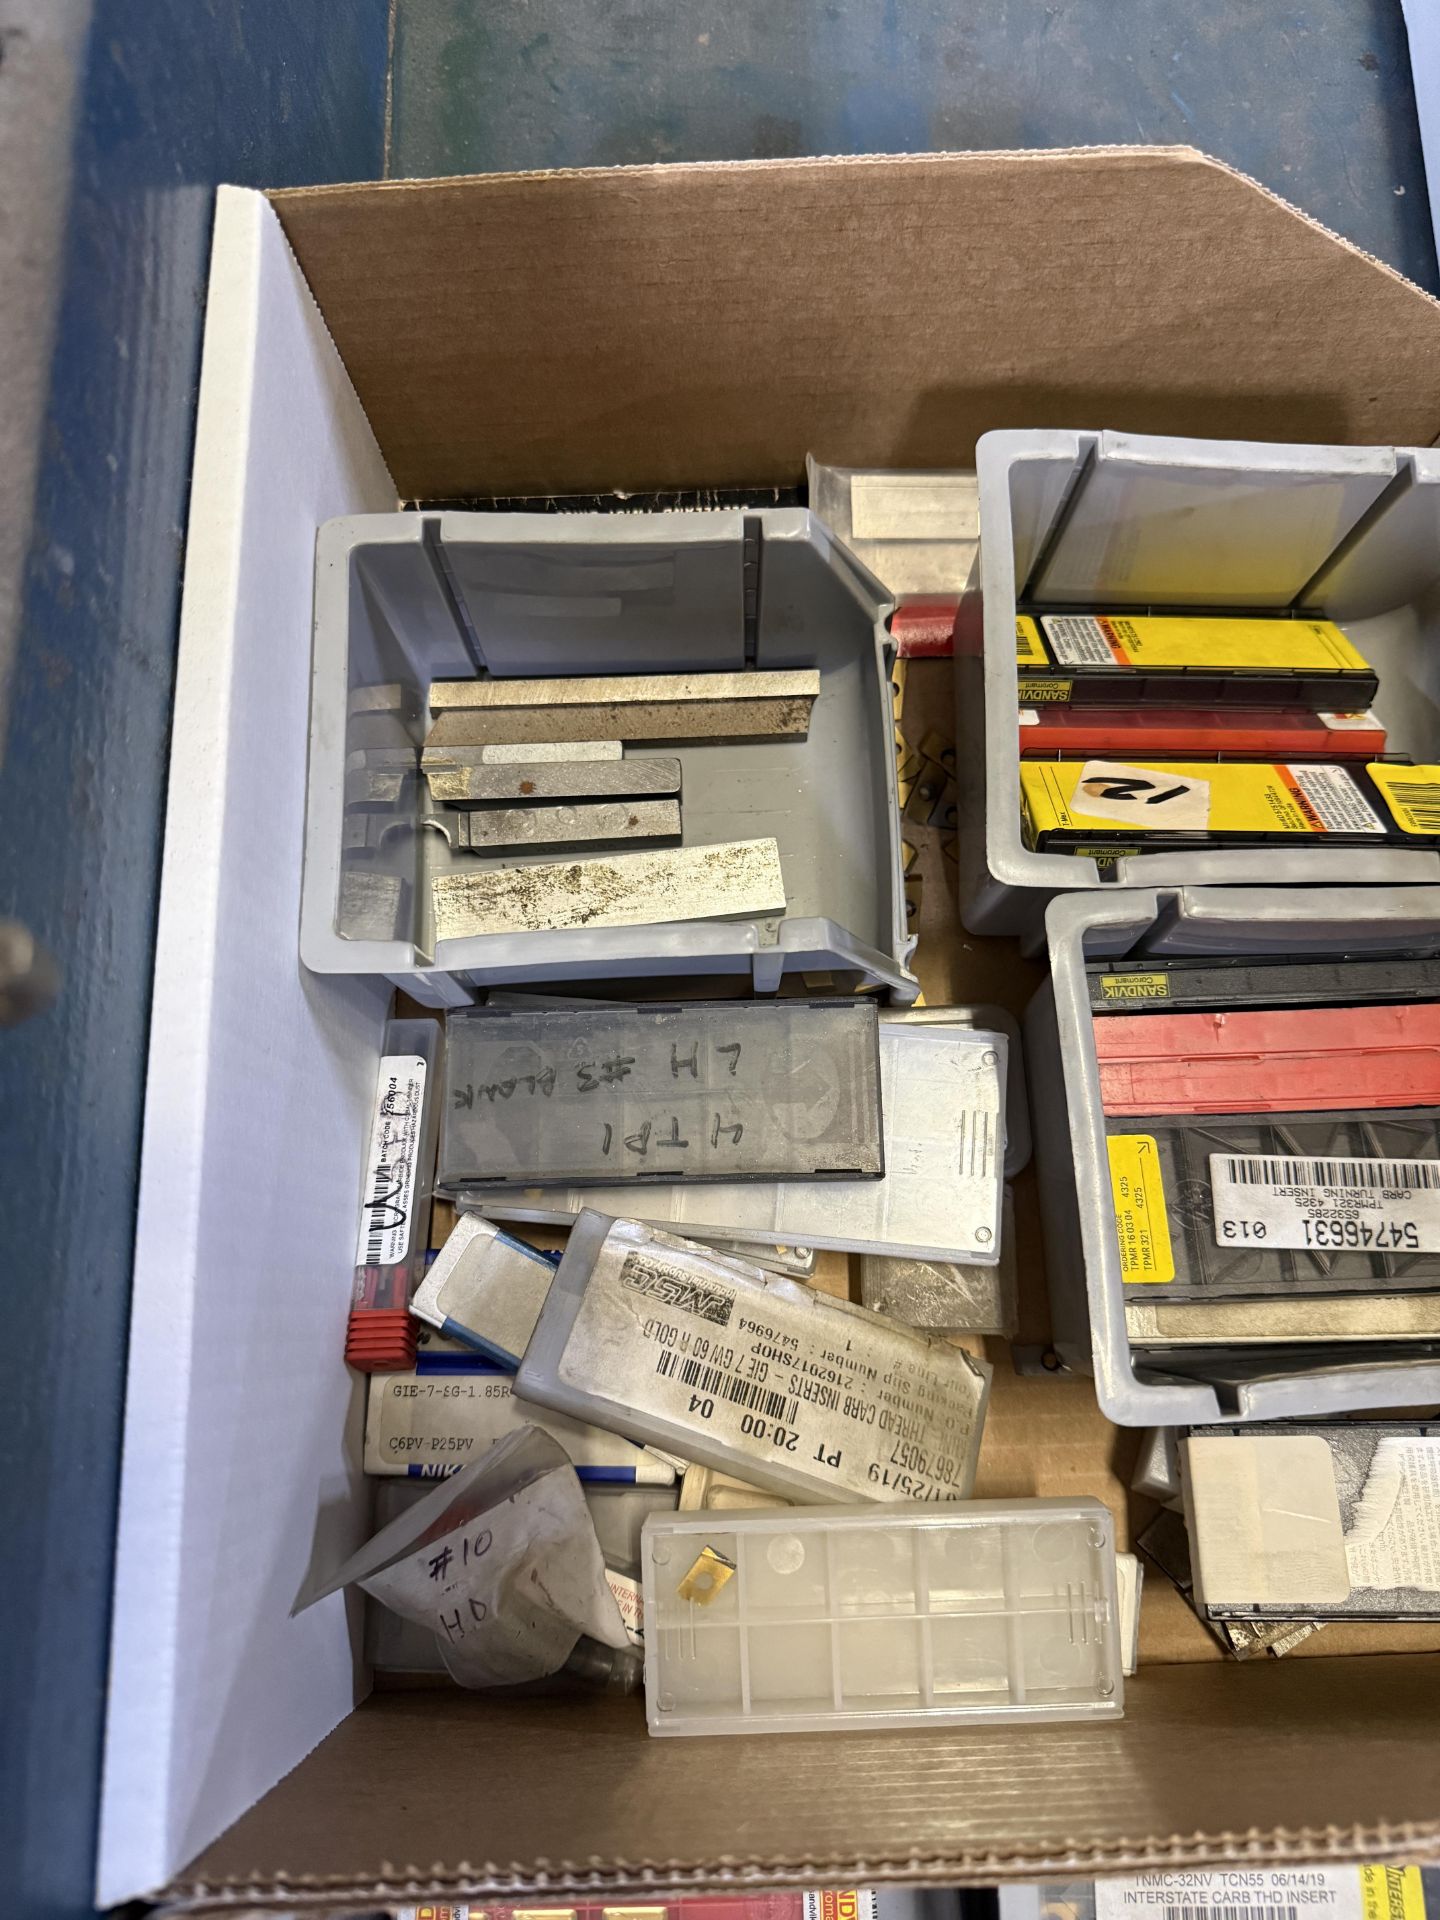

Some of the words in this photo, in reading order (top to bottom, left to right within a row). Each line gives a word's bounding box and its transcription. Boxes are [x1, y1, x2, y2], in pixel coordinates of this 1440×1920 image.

[1289, 788, 1314, 826] WARNING
[1104, 985, 1167, 998] SANDVIK
[382, 1120, 391, 1138] CODE
[1119, 1176, 1129, 1198] 4325
[1134, 1187, 1143, 1209] 4325
[1272, 1186, 1315, 1198] INSERT
[1323, 1188, 1376, 1199] TURNING
[1382, 1190, 1412, 1200] CARB
[1295, 1197, 1324, 1208] 4325
[1308, 1208, 1360, 1220] 6532285
[1334, 1199, 1384, 1209] TPMR321
[1140, 1229, 1150, 1247] 321
[1223, 1220, 1267, 1239] 013
[1302, 1219, 1420, 1249] 54746631
[1118, 1235, 1129, 1272] ORDERING
[1130, 1249, 1139, 1271] TPMR
[1142, 1249, 1152, 1271] TPMR
[621, 1261, 724, 1322] MSC
[640, 1316, 679, 1347] GOLD
[736, 1315, 800, 1351] 5476964
[690, 1336, 711, 1359] 60
[707, 1343, 735, 1369] GW
[743, 1356, 771, 1383] GIE
[749, 1339, 854, 1390] 2162017SHOP
[817, 1347, 878, 1382] Number
[393, 1385, 513, 1398] GIE-7-SG-1.85R
[784, 1372, 842, 1411] INSERTS
[685, 1392, 716, 1419] 04
[839, 1394, 878, 1425] CARB
[875, 1388, 935, 1421] Number
[738, 1412, 800, 1453] 20:00
[875, 1407, 928, 1444] THREAD
[811, 1441, 844, 1469] PT
[887, 1438, 967, 1489] 78679057
[421, 1463, 467, 1478] NIK
[429, 1530, 492, 1581] #10
[1219, 1873, 1264, 1887] TCN55
[1271, 1873, 1325, 1887] 06/14/19
[1124, 1890, 1208, 1904] INTERSTATE
[1213, 1890, 1251, 1904] CARB
[1254, 1890, 1283, 1904] THD
[1286, 1890, 1337, 1904] INSERT
